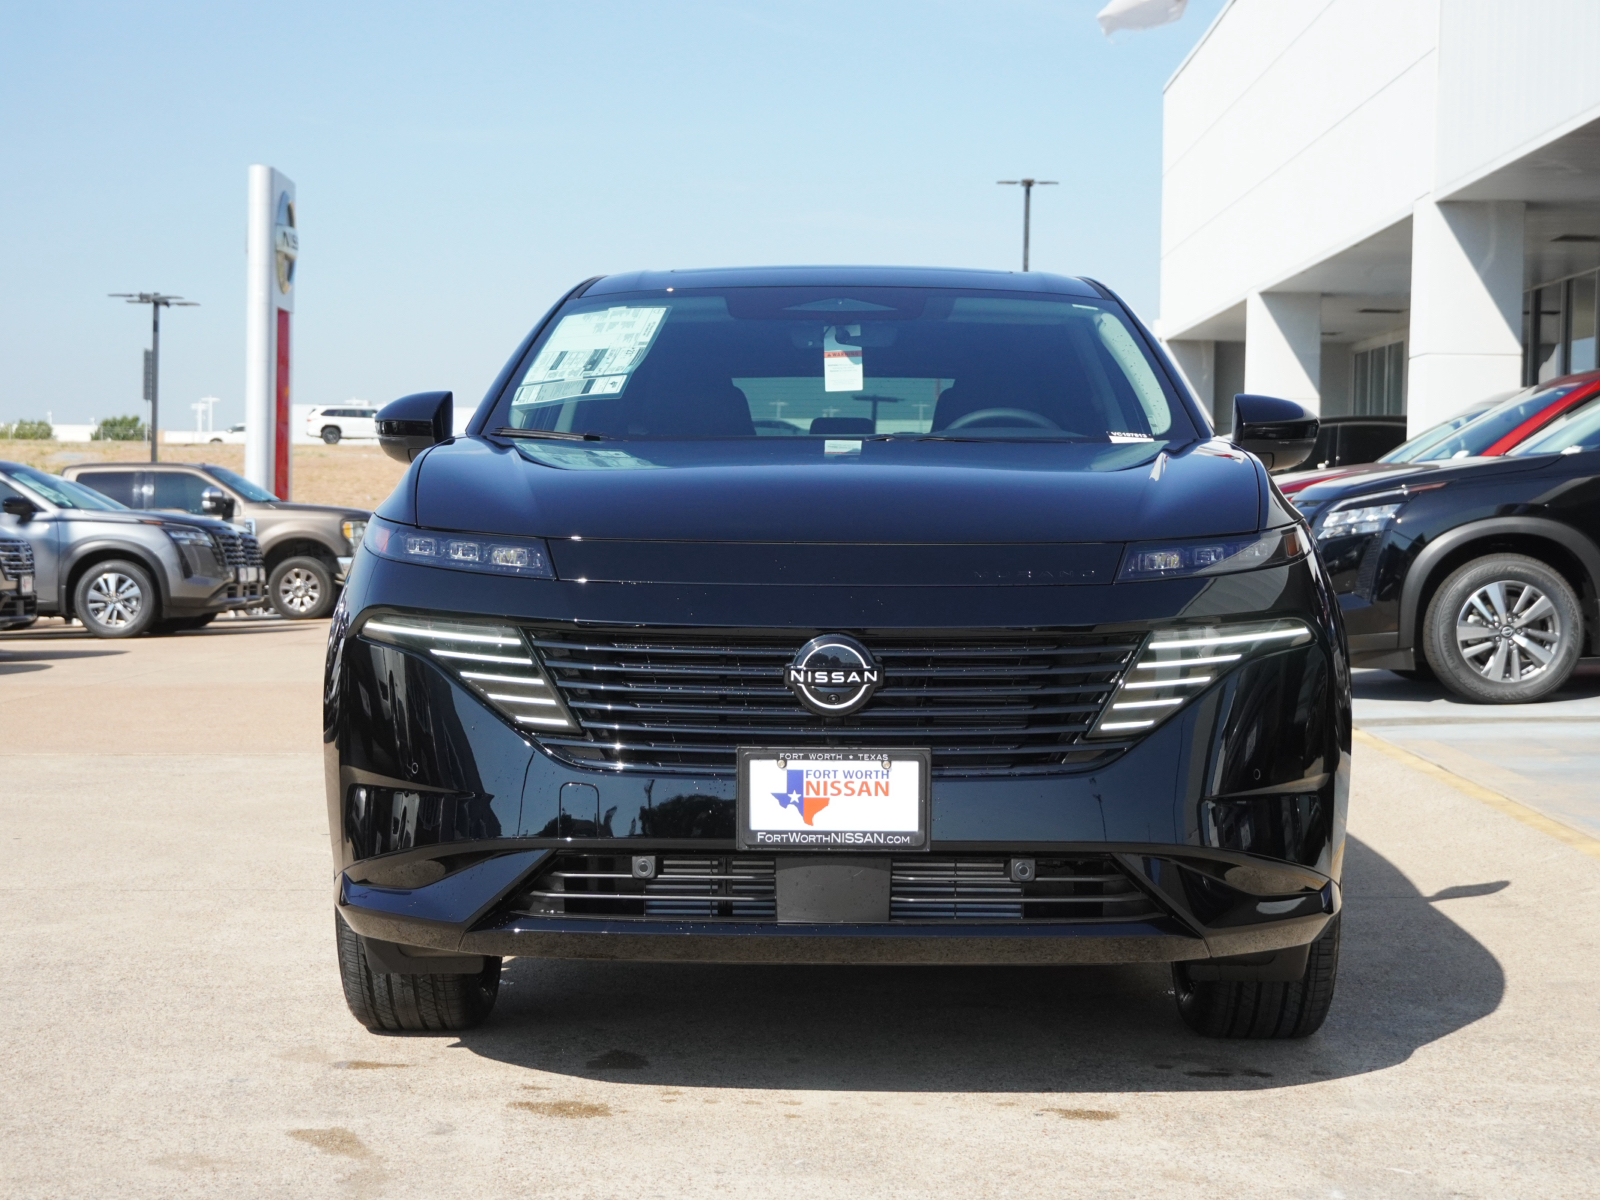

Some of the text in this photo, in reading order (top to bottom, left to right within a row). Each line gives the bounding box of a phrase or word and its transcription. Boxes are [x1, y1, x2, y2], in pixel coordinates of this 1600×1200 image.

[790, 670, 878, 683] NISSAN
[858, 753, 889, 761] TEXAS
[805, 769, 890, 780] FORT WORTH
[805, 780, 890, 797] NISSAN
